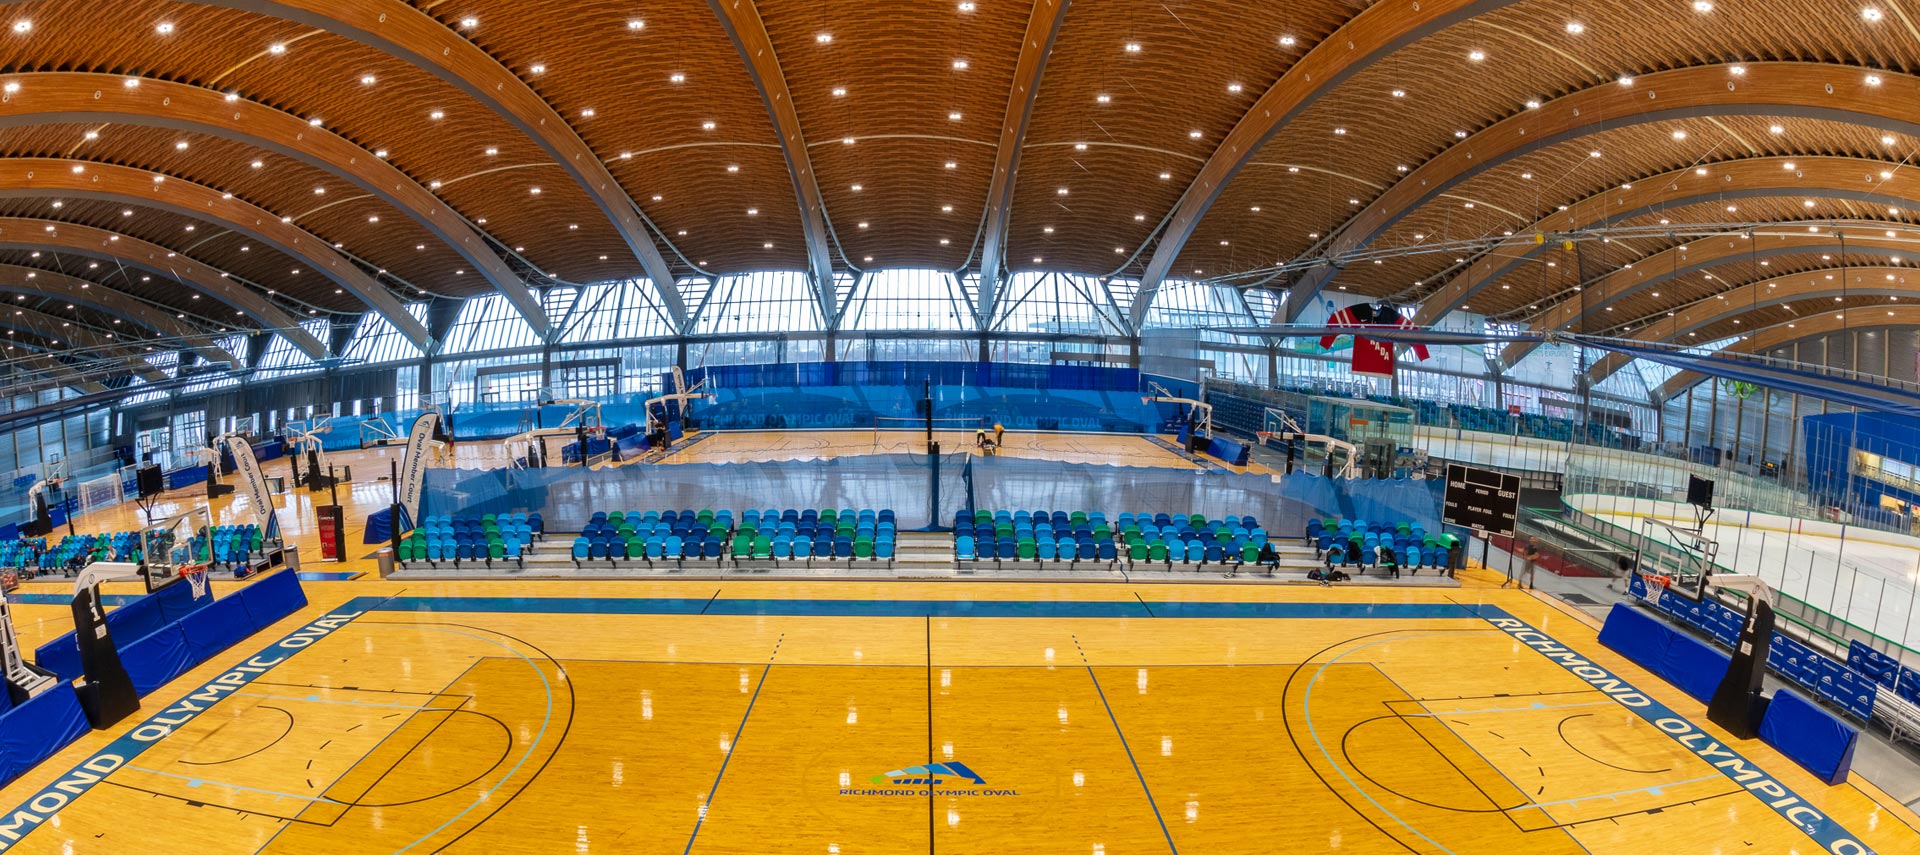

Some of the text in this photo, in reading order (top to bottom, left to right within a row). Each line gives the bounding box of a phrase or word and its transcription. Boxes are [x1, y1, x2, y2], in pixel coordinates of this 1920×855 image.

[406, 432, 426, 503] Oval Member Court
[240, 453, 267, 515] Oval Member Court
[1450, 481, 1465, 489] HOME
[1498, 490, 1515, 498] GUEST
[90, 606, 100, 622] 1
[1746, 618, 1755, 634] 1
[0, 610, 364, 849] MOND OLYMPIC OVAL
[1488, 618, 1823, 829] RICHMOND OLYMPIC
[839, 788, 915, 796] RICHMOND
